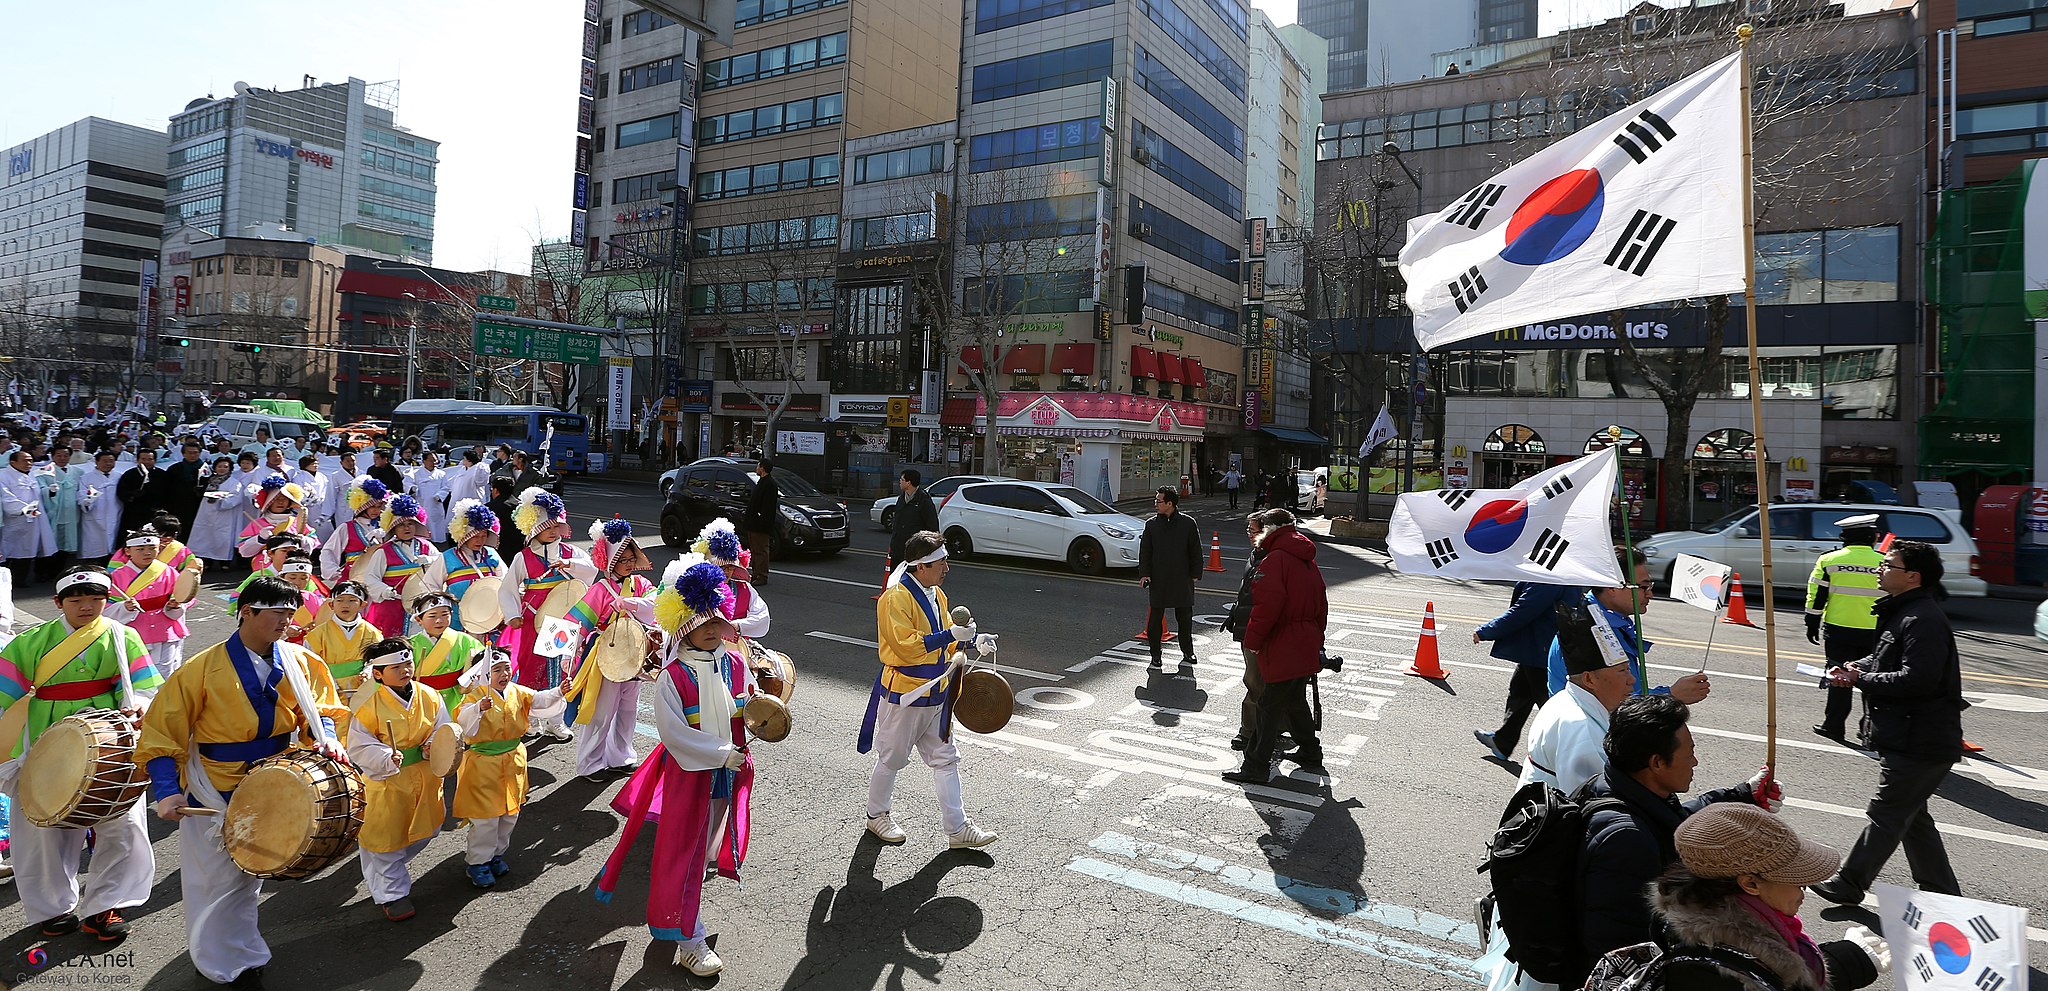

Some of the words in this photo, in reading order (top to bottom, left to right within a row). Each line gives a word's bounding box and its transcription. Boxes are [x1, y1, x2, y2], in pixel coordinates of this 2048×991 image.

[255, 138, 293, 161] YBM
[10, 149, 32, 177] YBM
[482, 297, 514, 308] 종로2가
[484, 328, 517, 340] 안국역
[534, 331, 560, 342] 흥인지문
[567, 337, 597, 349] 청계2가
[532, 350, 559, 360] 종로3가
[764, 394, 786, 405] KFC
[841, 403, 884, 411] TONYMOLY
[1245, 391, 1255, 426] SUNOO
[1030, 410, 1060, 421] ETUDE
[1838, 565, 1883, 575] POLIC
